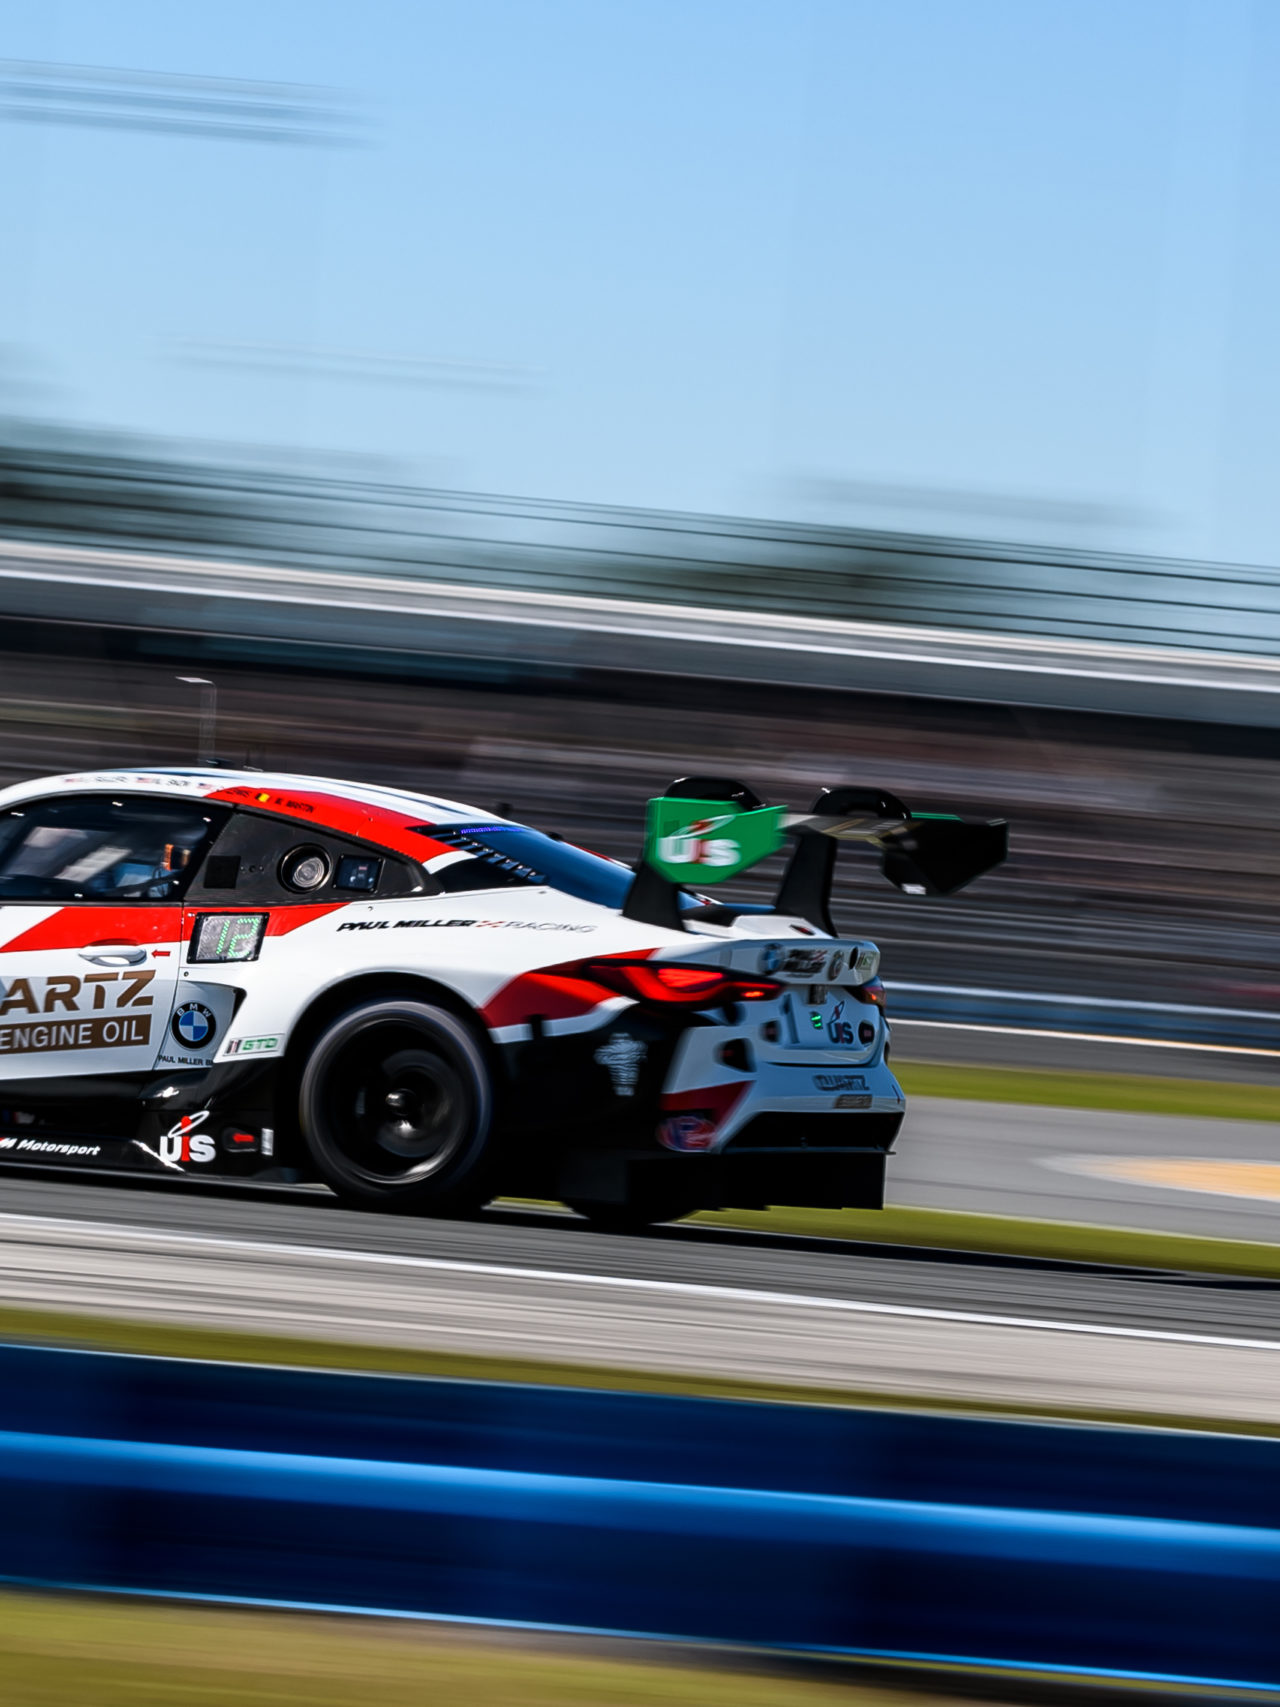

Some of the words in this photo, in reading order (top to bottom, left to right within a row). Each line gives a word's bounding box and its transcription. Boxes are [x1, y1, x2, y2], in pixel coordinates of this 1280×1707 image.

[337, 920, 389, 932] PAUL
[393, 919, 477, 929] MILLER
[505, 921, 597, 933] RACING
[176, 1003, 212, 1018] BMW
[102, 1019, 144, 1043] OIL
[242, 1037, 278, 1051] GTD
[158, 1055, 176, 1063] PAUL
[177, 1056, 203, 1065] MILLER
[18, 1138, 101, 1156] Motorsport
